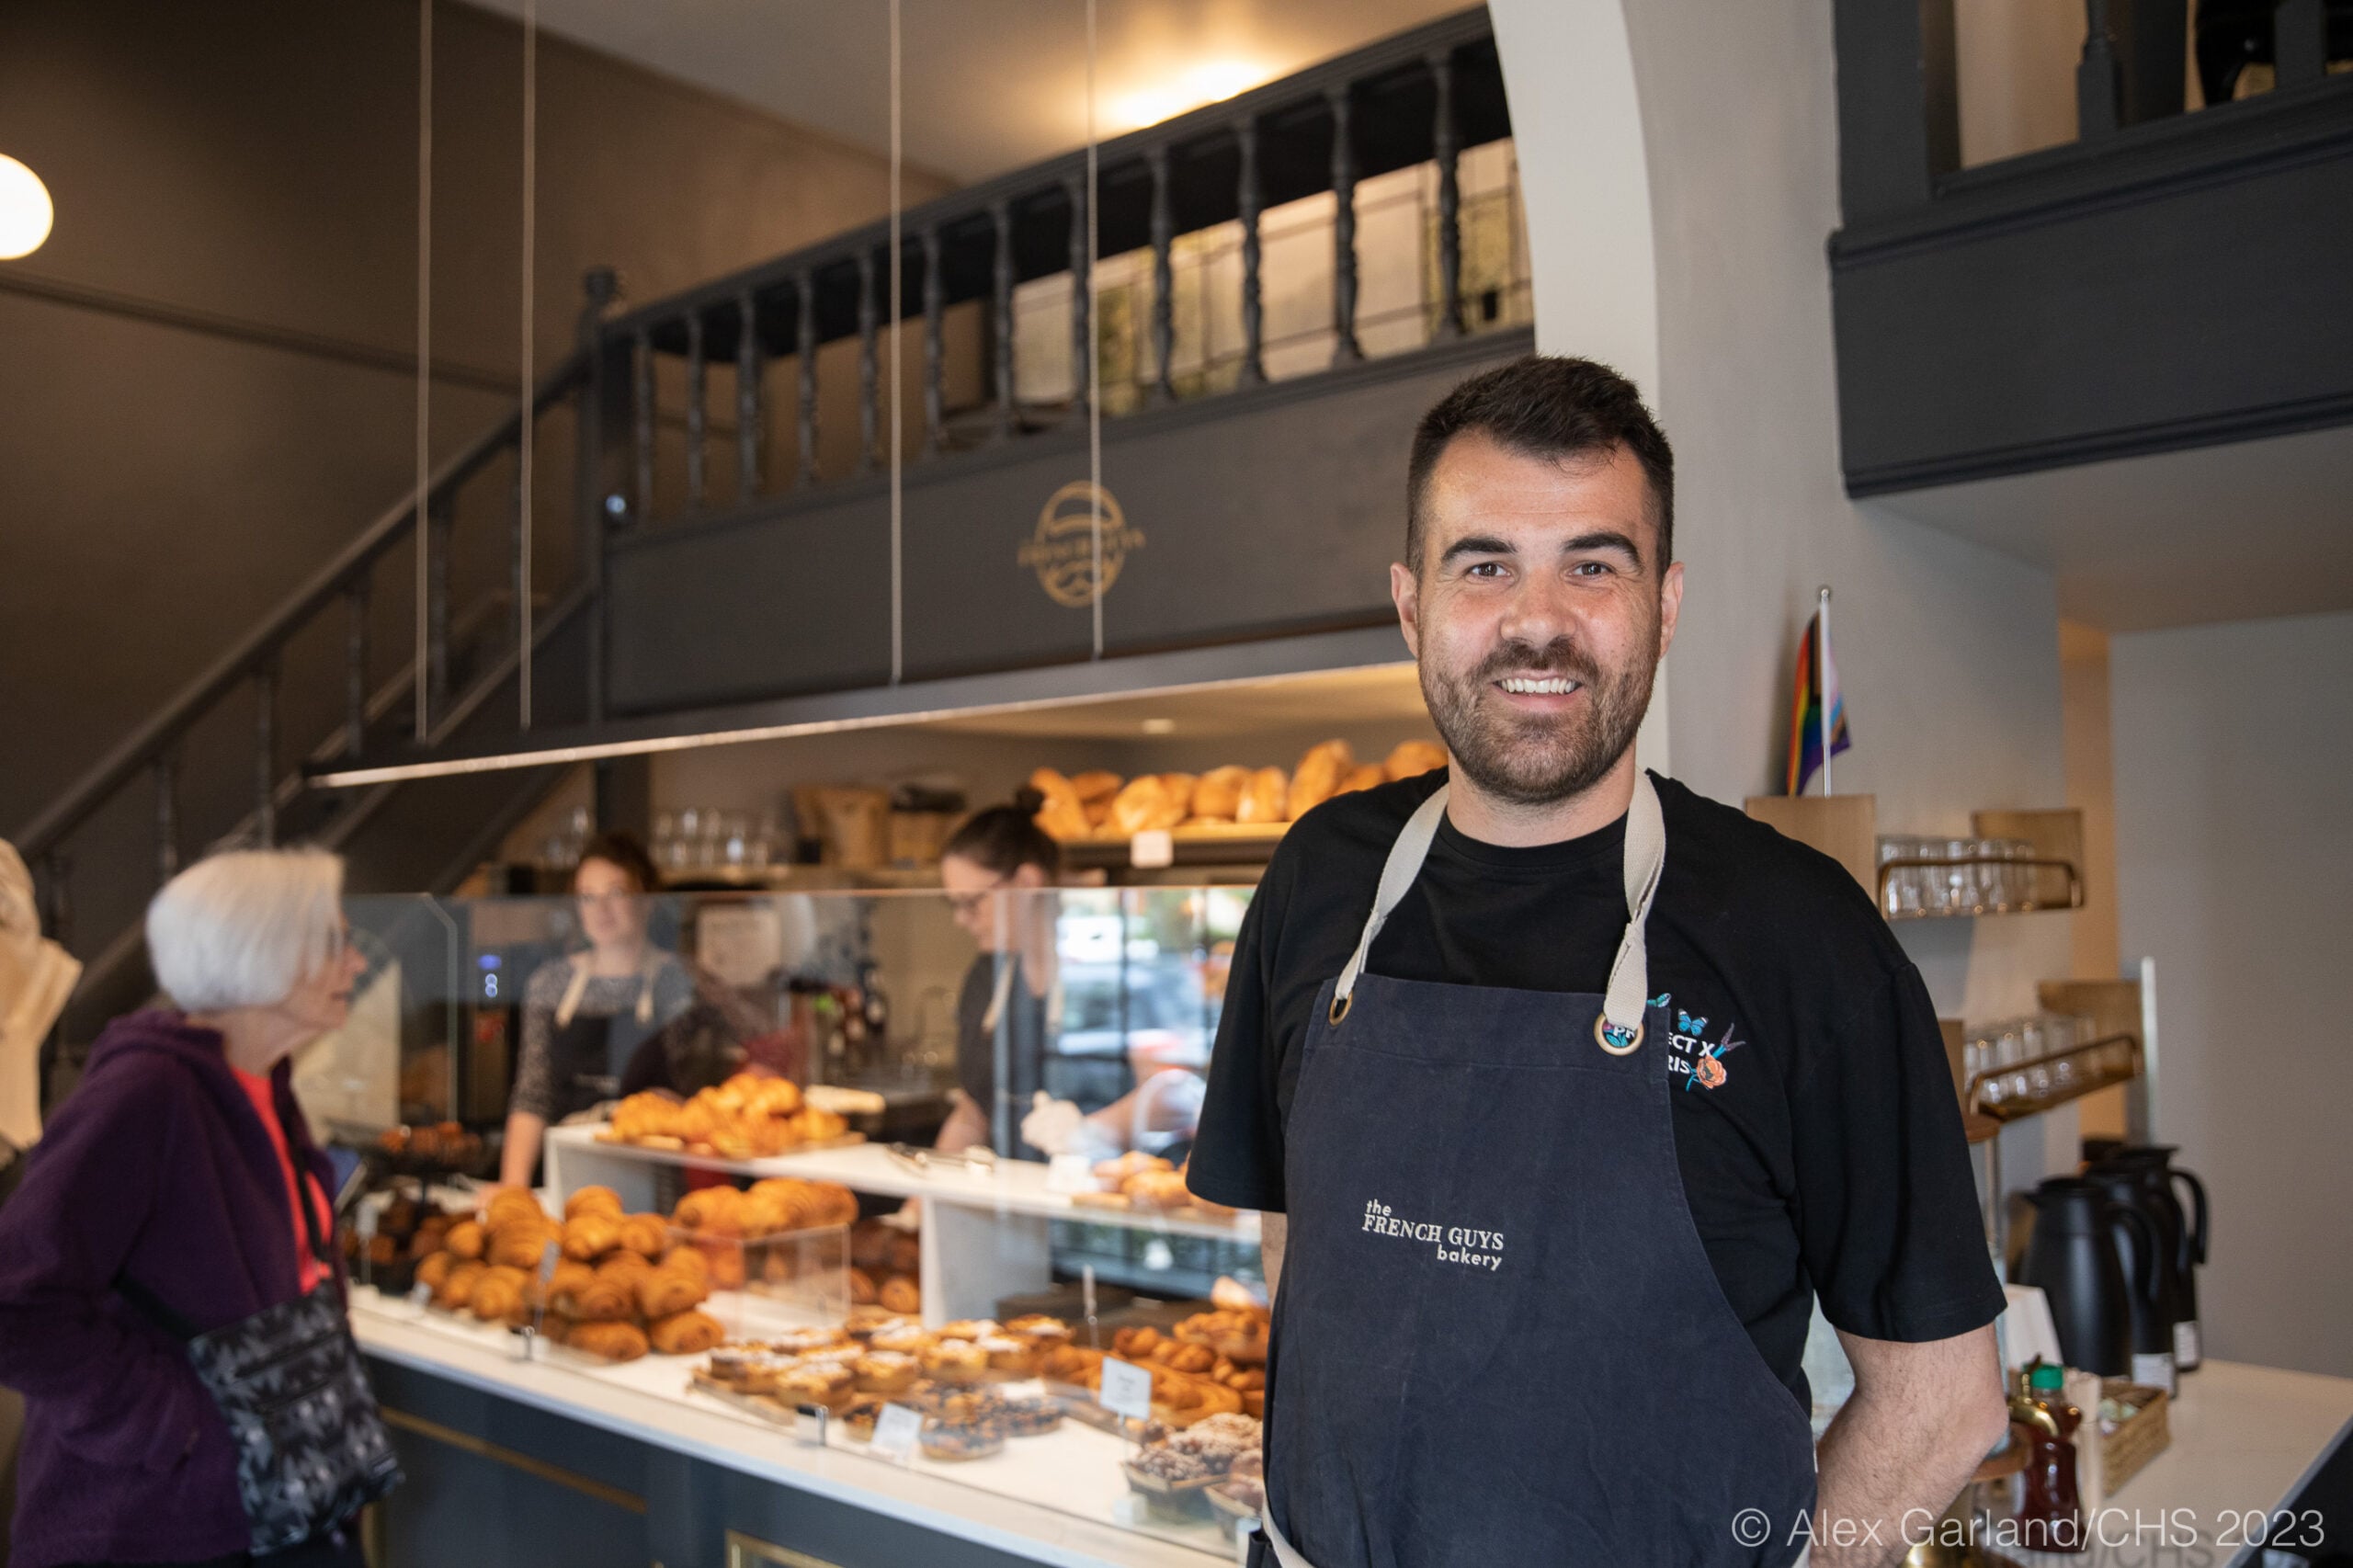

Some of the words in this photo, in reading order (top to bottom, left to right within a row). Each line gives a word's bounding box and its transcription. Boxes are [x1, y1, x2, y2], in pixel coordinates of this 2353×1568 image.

[1699, 1040, 1715, 1057] X
[1366, 1199, 1392, 1216] the
[1361, 1213, 1443, 1243] FRENCH
[1448, 1227, 1504, 1251] GUYS
[1437, 1244, 1502, 1271] bakery
